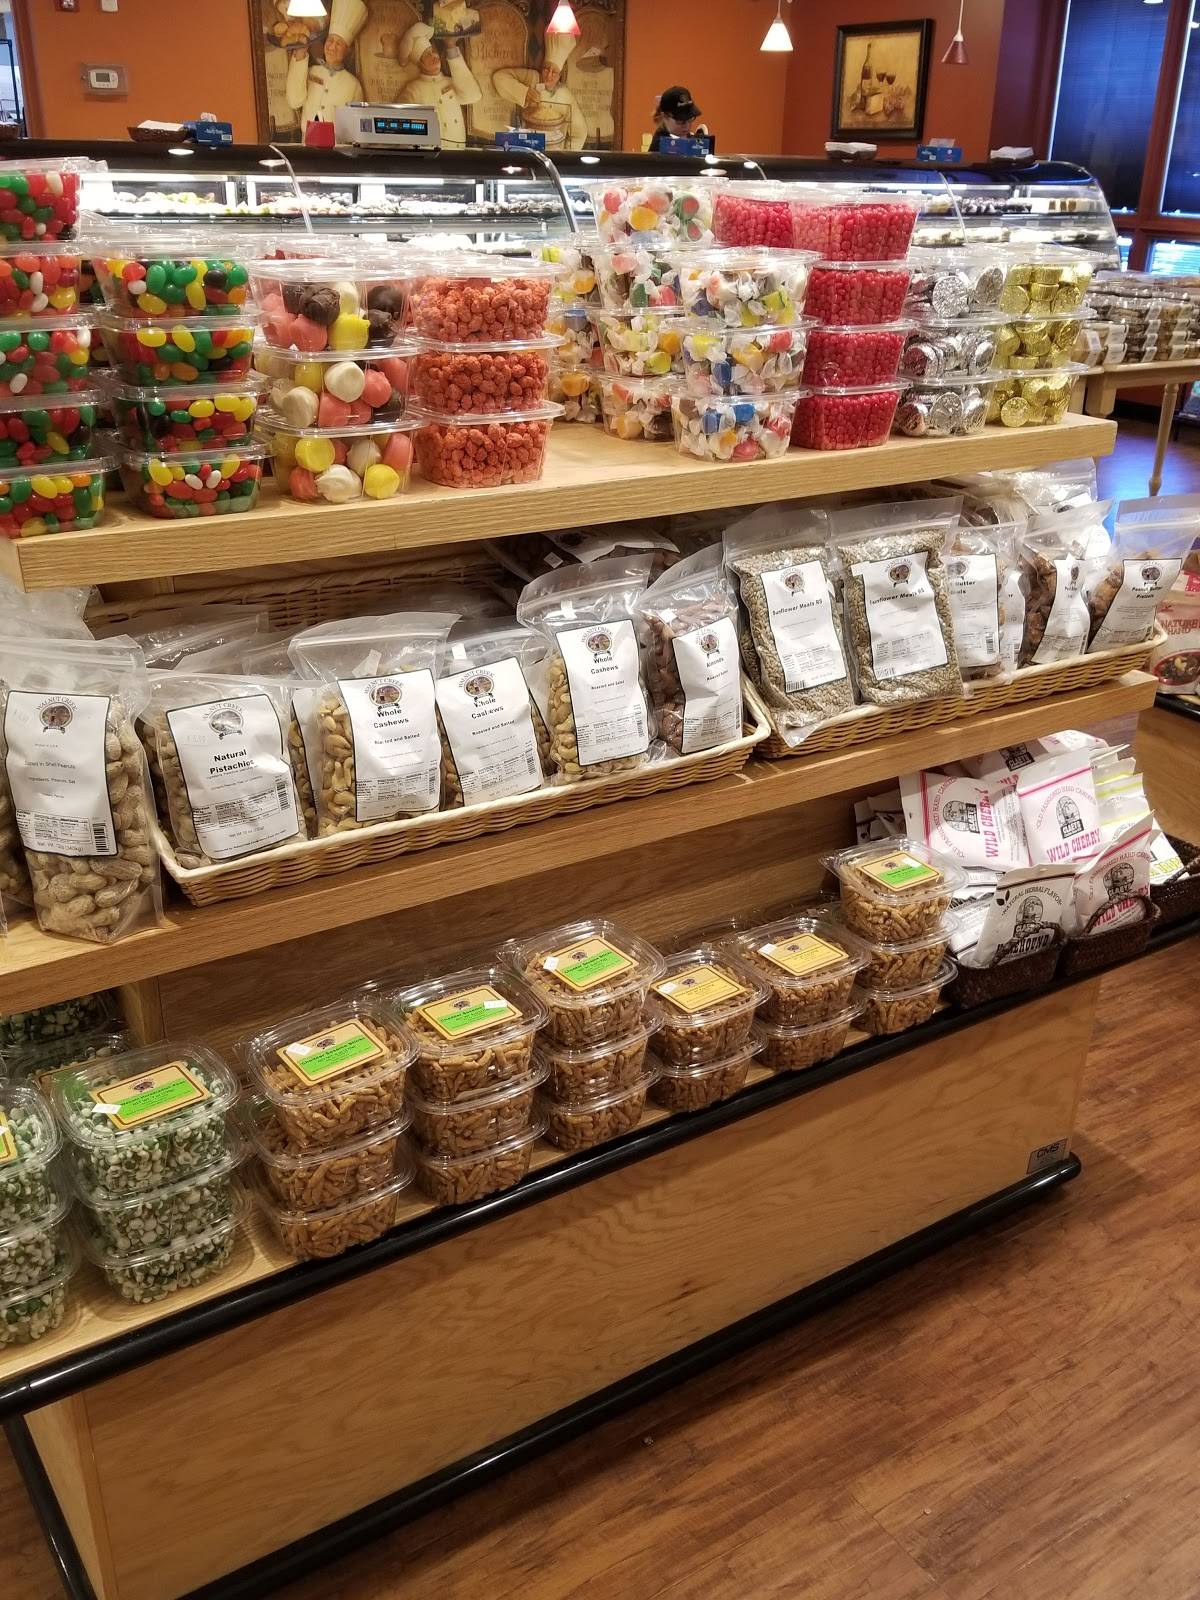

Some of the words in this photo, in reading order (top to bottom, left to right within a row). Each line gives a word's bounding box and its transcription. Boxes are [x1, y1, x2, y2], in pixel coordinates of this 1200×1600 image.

[772, 605, 798, 616] Sunflower
[1160, 618, 1200, 629] NATURE
[593, 655, 613, 665] Whole
[590, 664, 619, 675] Cashews
[376, 708, 403, 718] Whole
[373, 717, 410, 729] Cashews
[403, 732, 421, 742] Salted
[213, 748, 248, 763] Natural
[997, 774, 1019, 785] ILD
[983, 829, 999, 859] WILD
[1046, 842, 1071, 863] WILD
[1071, 827, 1102, 854] CHERRY
[1024, 886, 1045, 895] HERBAL
[998, 934, 1055, 955] HEHOUND
